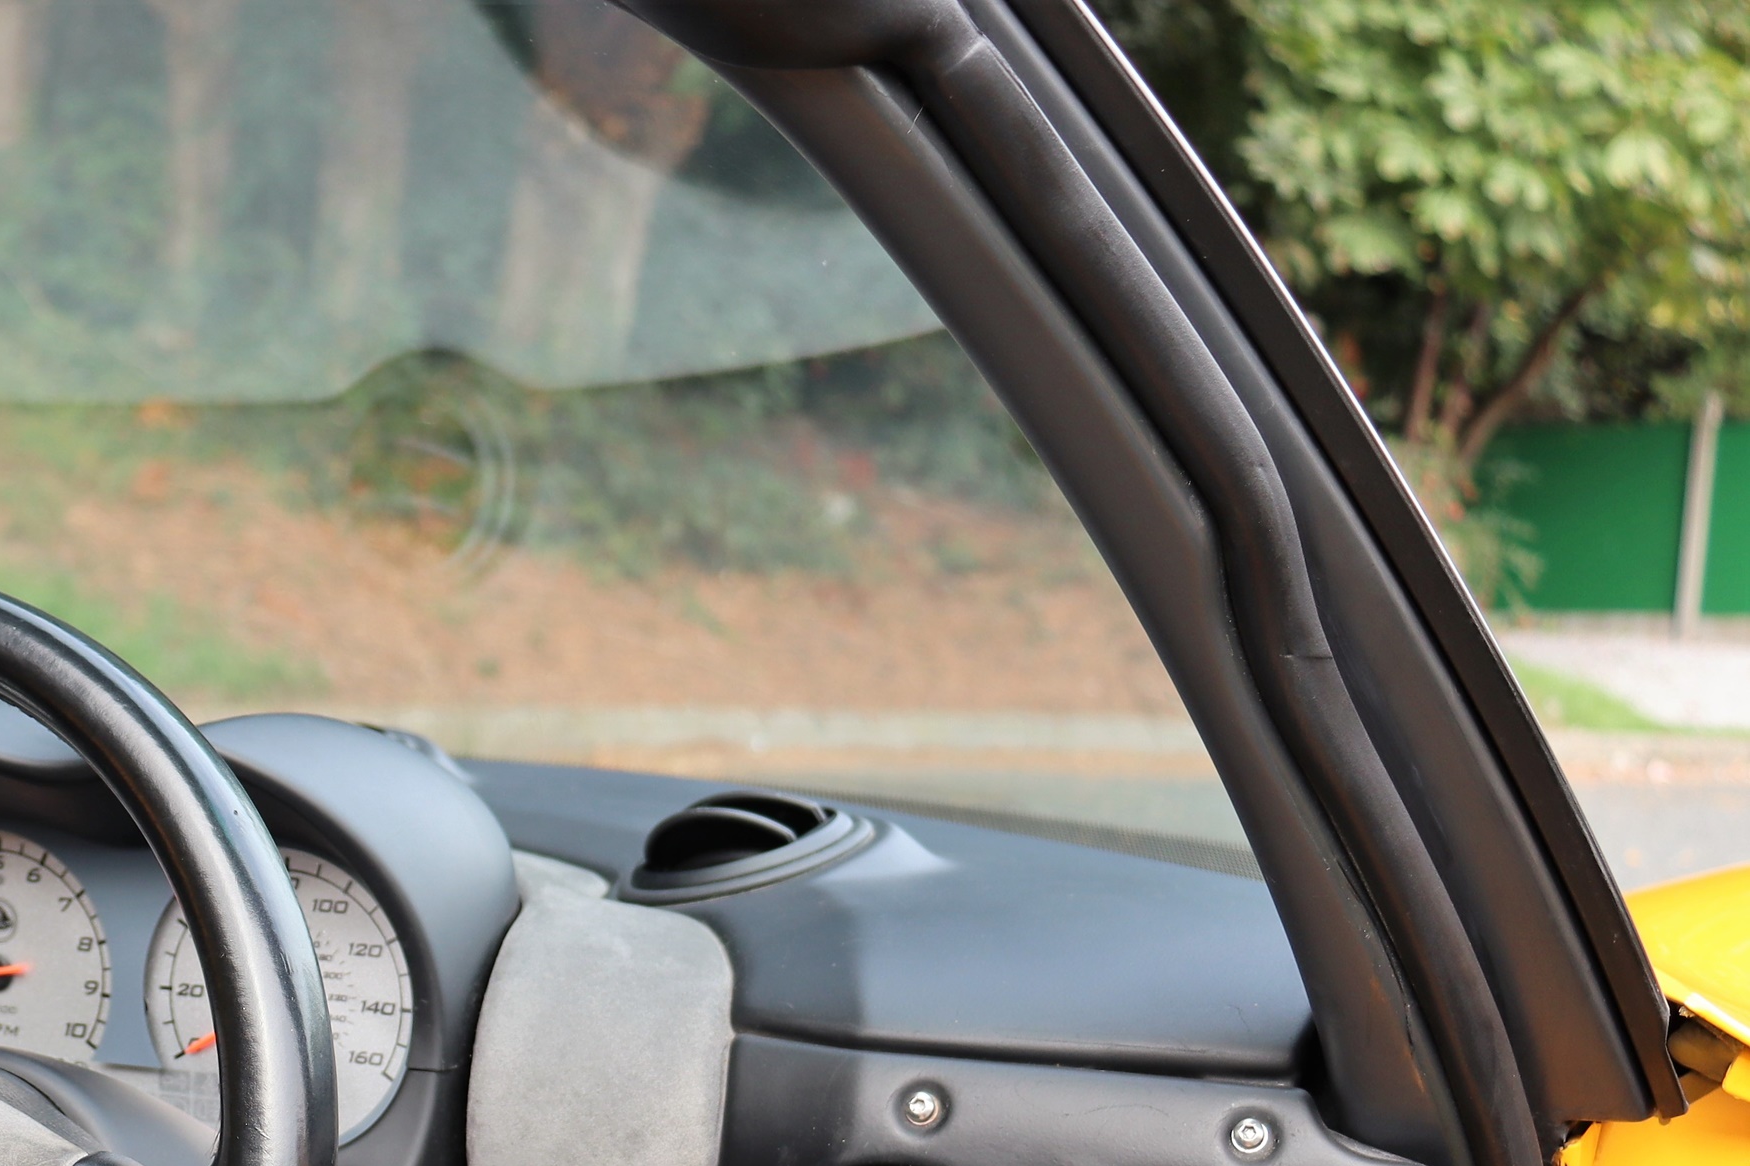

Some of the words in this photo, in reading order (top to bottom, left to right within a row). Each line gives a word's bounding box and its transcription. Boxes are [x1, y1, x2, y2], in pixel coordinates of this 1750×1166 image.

[26, 868, 41, 883] 6
[58, 897, 73, 912] 7
[312, 898, 349, 914] 100
[77, 937, 94, 952] 8
[348, 943, 383, 958] 120
[84, 980, 99, 995] 9
[177, 983, 205, 998] 20
[360, 1000, 396, 1016] 140
[65, 1022, 87, 1038] 10
[349, 1050, 384, 1066] 160
